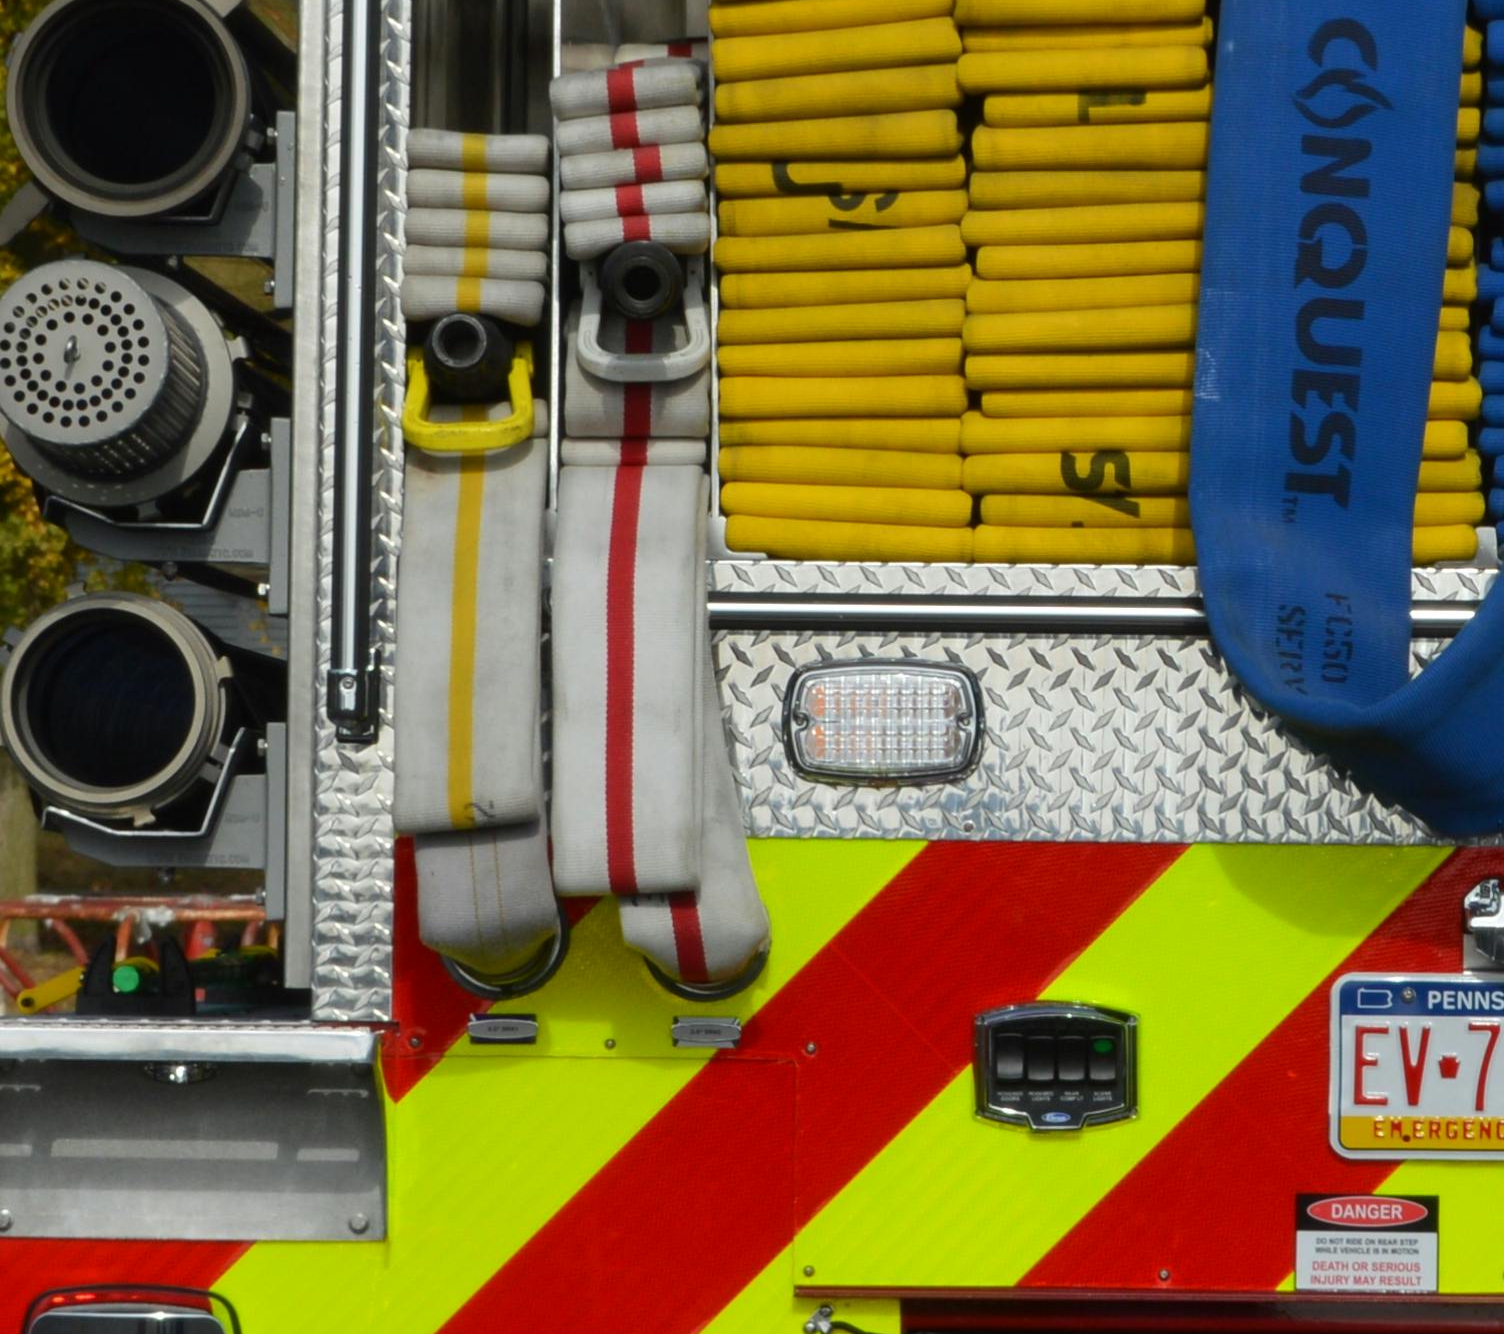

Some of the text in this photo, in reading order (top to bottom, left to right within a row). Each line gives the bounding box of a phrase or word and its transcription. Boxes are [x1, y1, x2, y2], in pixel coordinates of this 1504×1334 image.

[1283, 17, 1393, 509] CONQUEST
[1331, 1203, 1403, 1219] DANGER
[1400, 1238, 1418, 1246] STEP
[1340, 1247, 1370, 1255] VEHICLE
[1373, 1247, 1379, 1255] IS
[1312, 1260, 1421, 1272] DEATH OR SERIOUS
[1310, 1275, 1422, 1286] INJURY MAY RESULT
